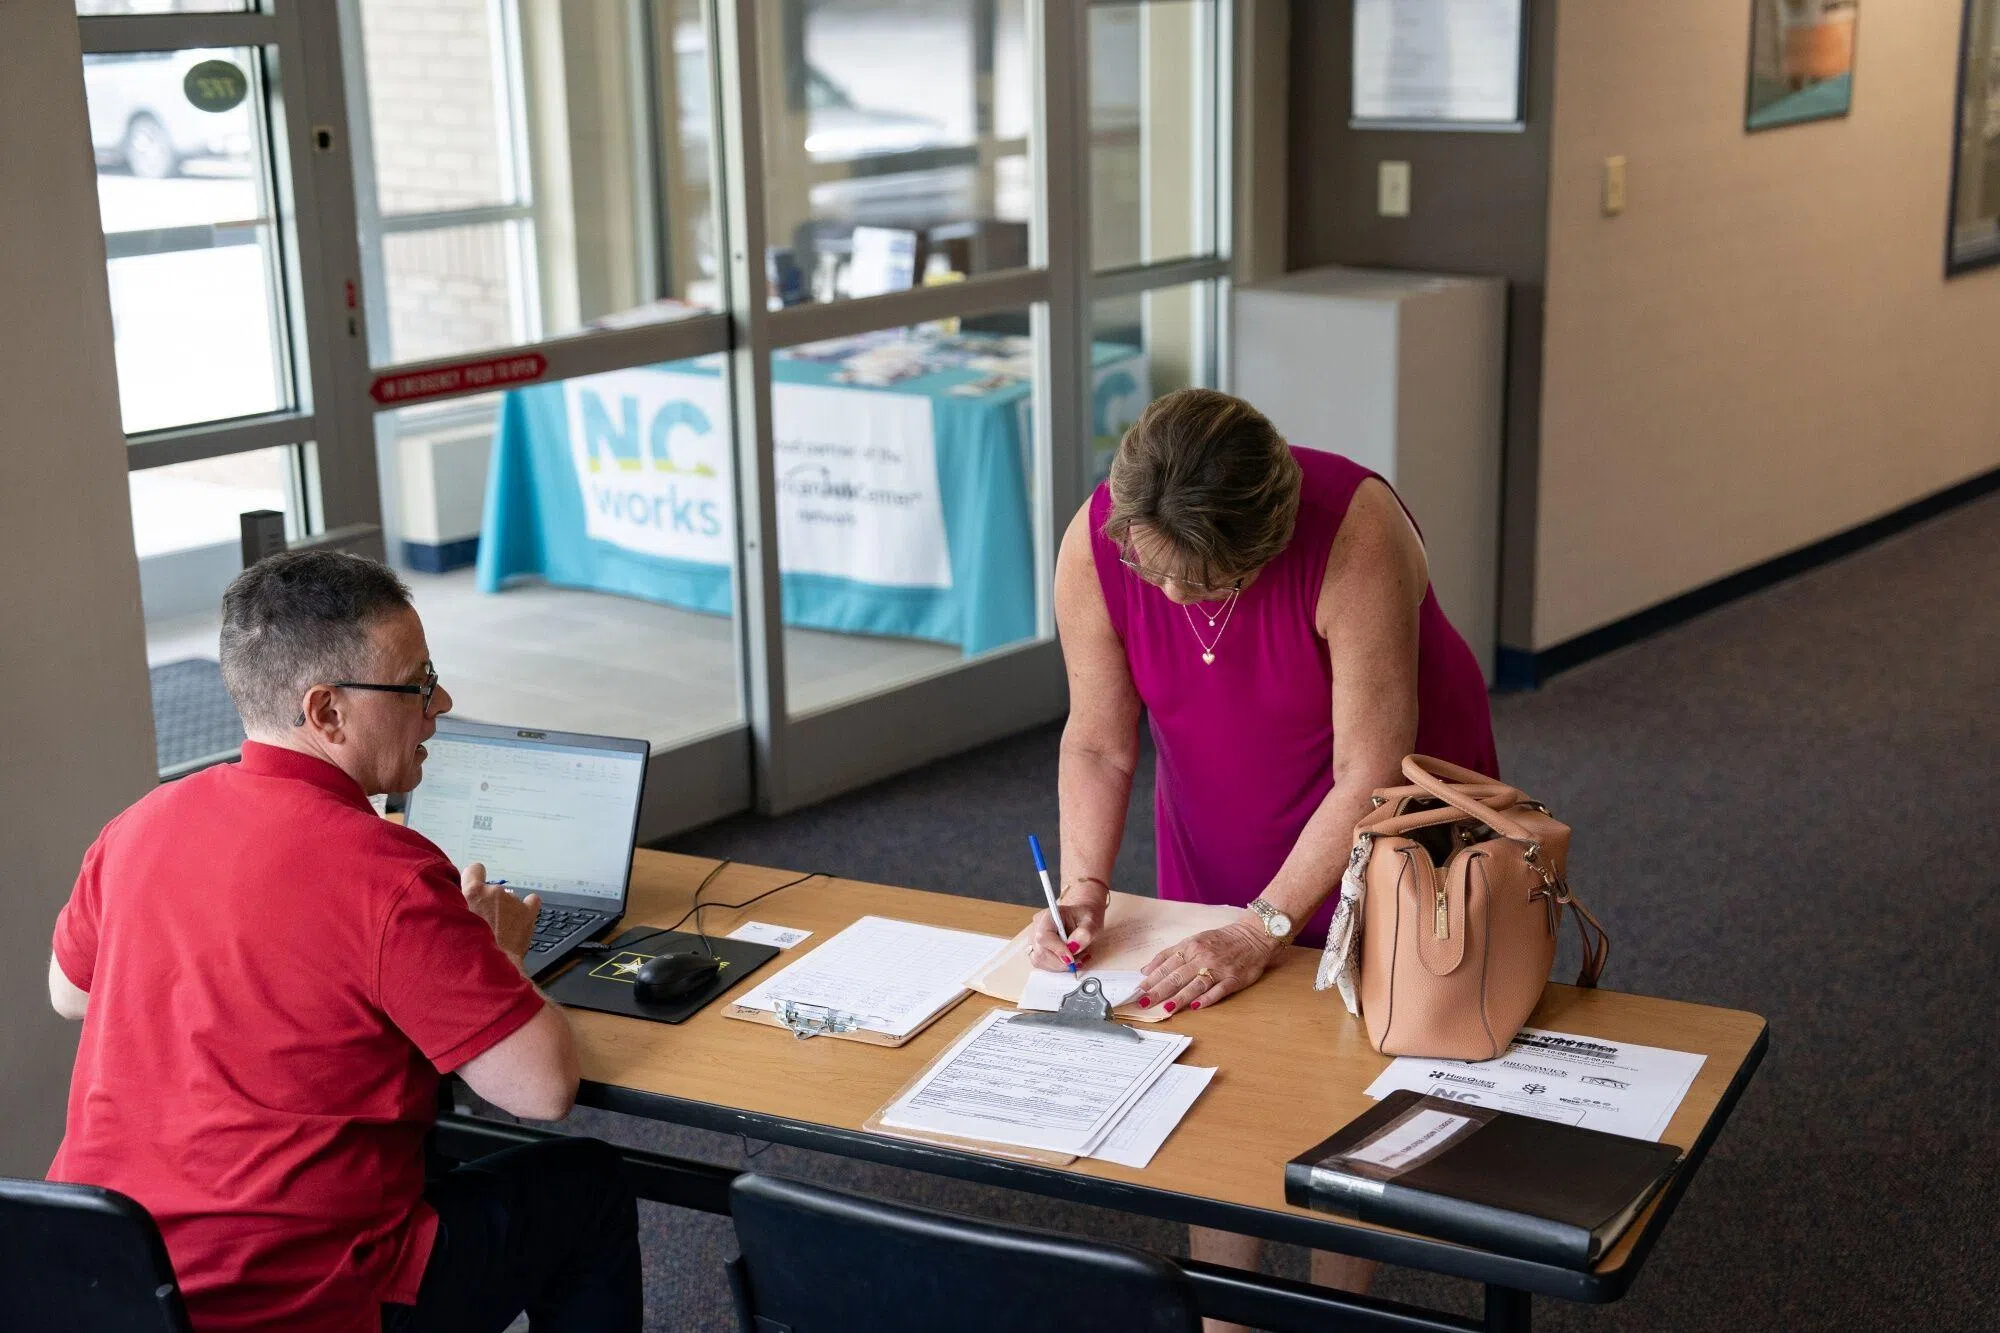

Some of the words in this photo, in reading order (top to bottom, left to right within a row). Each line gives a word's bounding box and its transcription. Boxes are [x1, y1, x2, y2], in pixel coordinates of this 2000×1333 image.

[579, 388, 715, 477] NC
[591, 479, 722, 537] works
[1502, 1060, 1569, 1077] BRUNSWICK
[1432, 1088, 1481, 1104] NC
